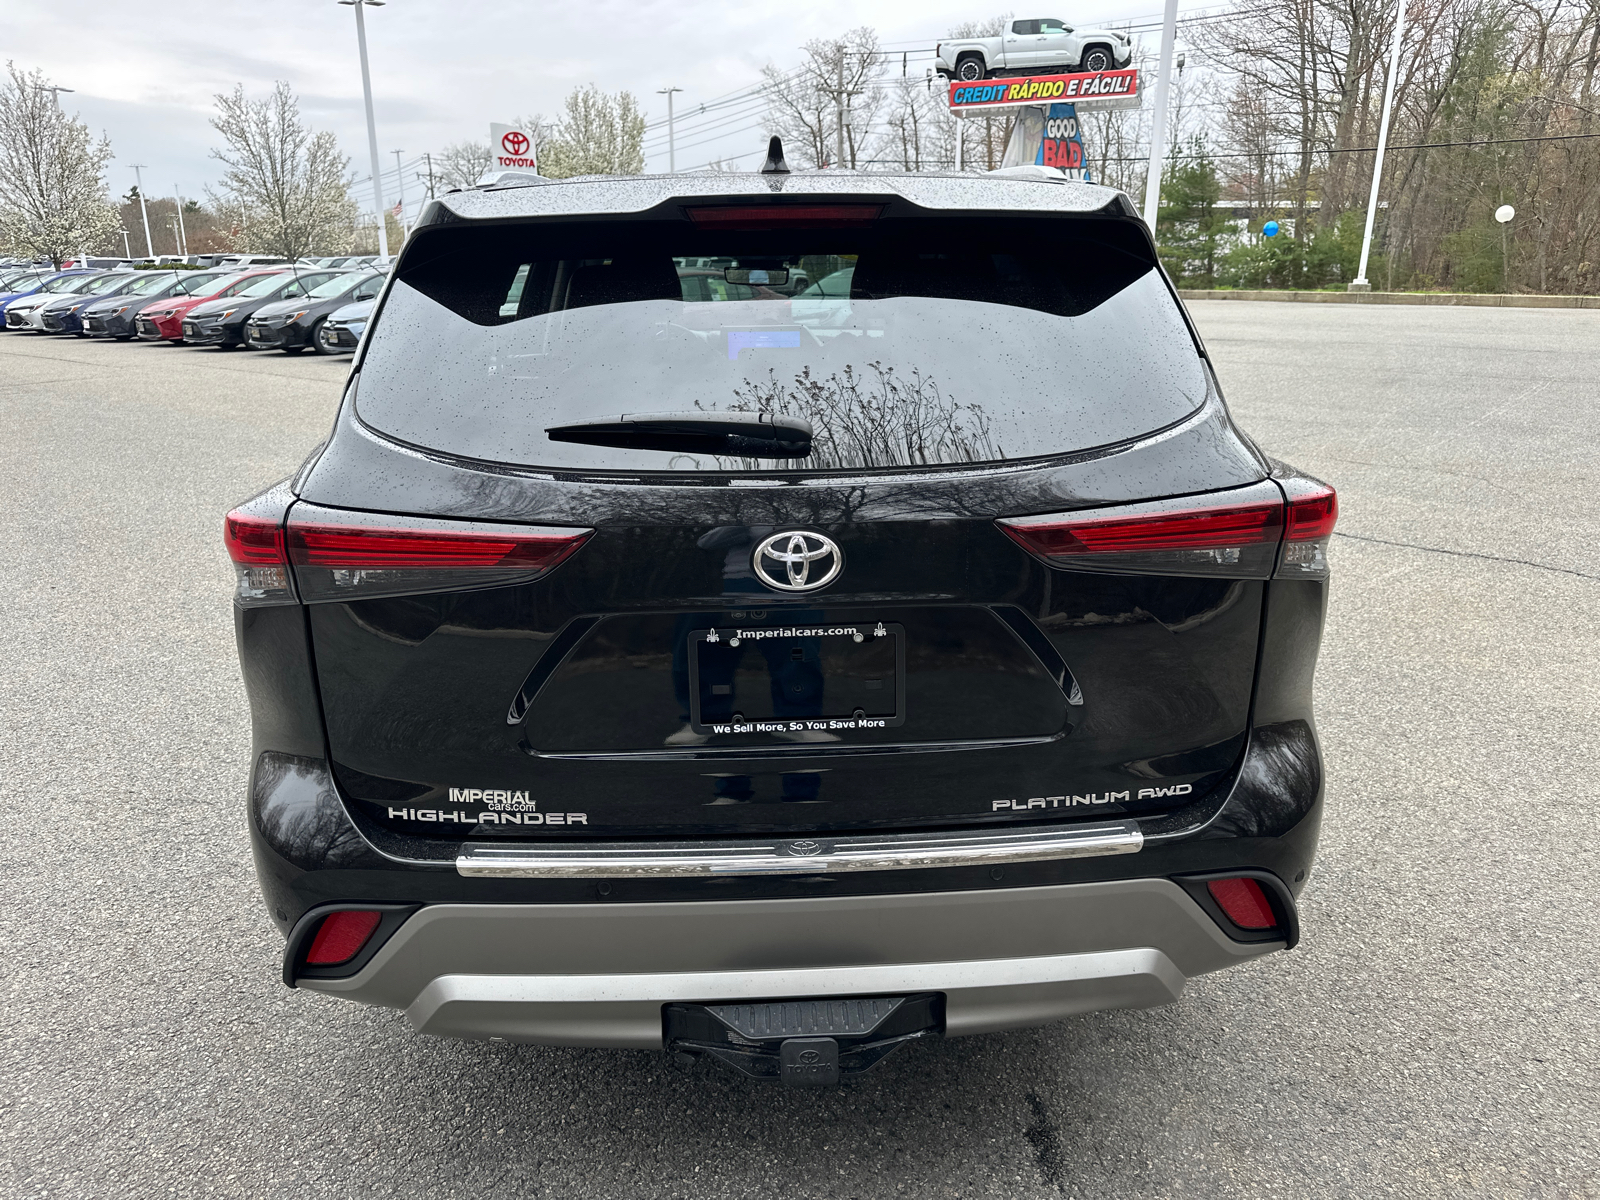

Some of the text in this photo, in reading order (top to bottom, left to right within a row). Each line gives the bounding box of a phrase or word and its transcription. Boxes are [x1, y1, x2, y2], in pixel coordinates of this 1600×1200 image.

[954, 74, 1132, 104] CREDIT RÁPIDO E FÁCIL!
[1047, 118, 1077, 138] GOOD
[497, 156, 535, 168] TOYOTA
[1043, 138, 1082, 169] BAD
[736, 627, 857, 640] Imperialcars.com
[713, 718, 886, 734] We Sell More, So You Save More
[448, 787, 537, 804] IMPERIAL
[992, 783, 1193, 811] PLATINUM AWD
[388, 806, 588, 825] HIGHLANDER
[488, 803, 536, 812] cars.com
[786, 1062, 834, 1073] TOYOTA
